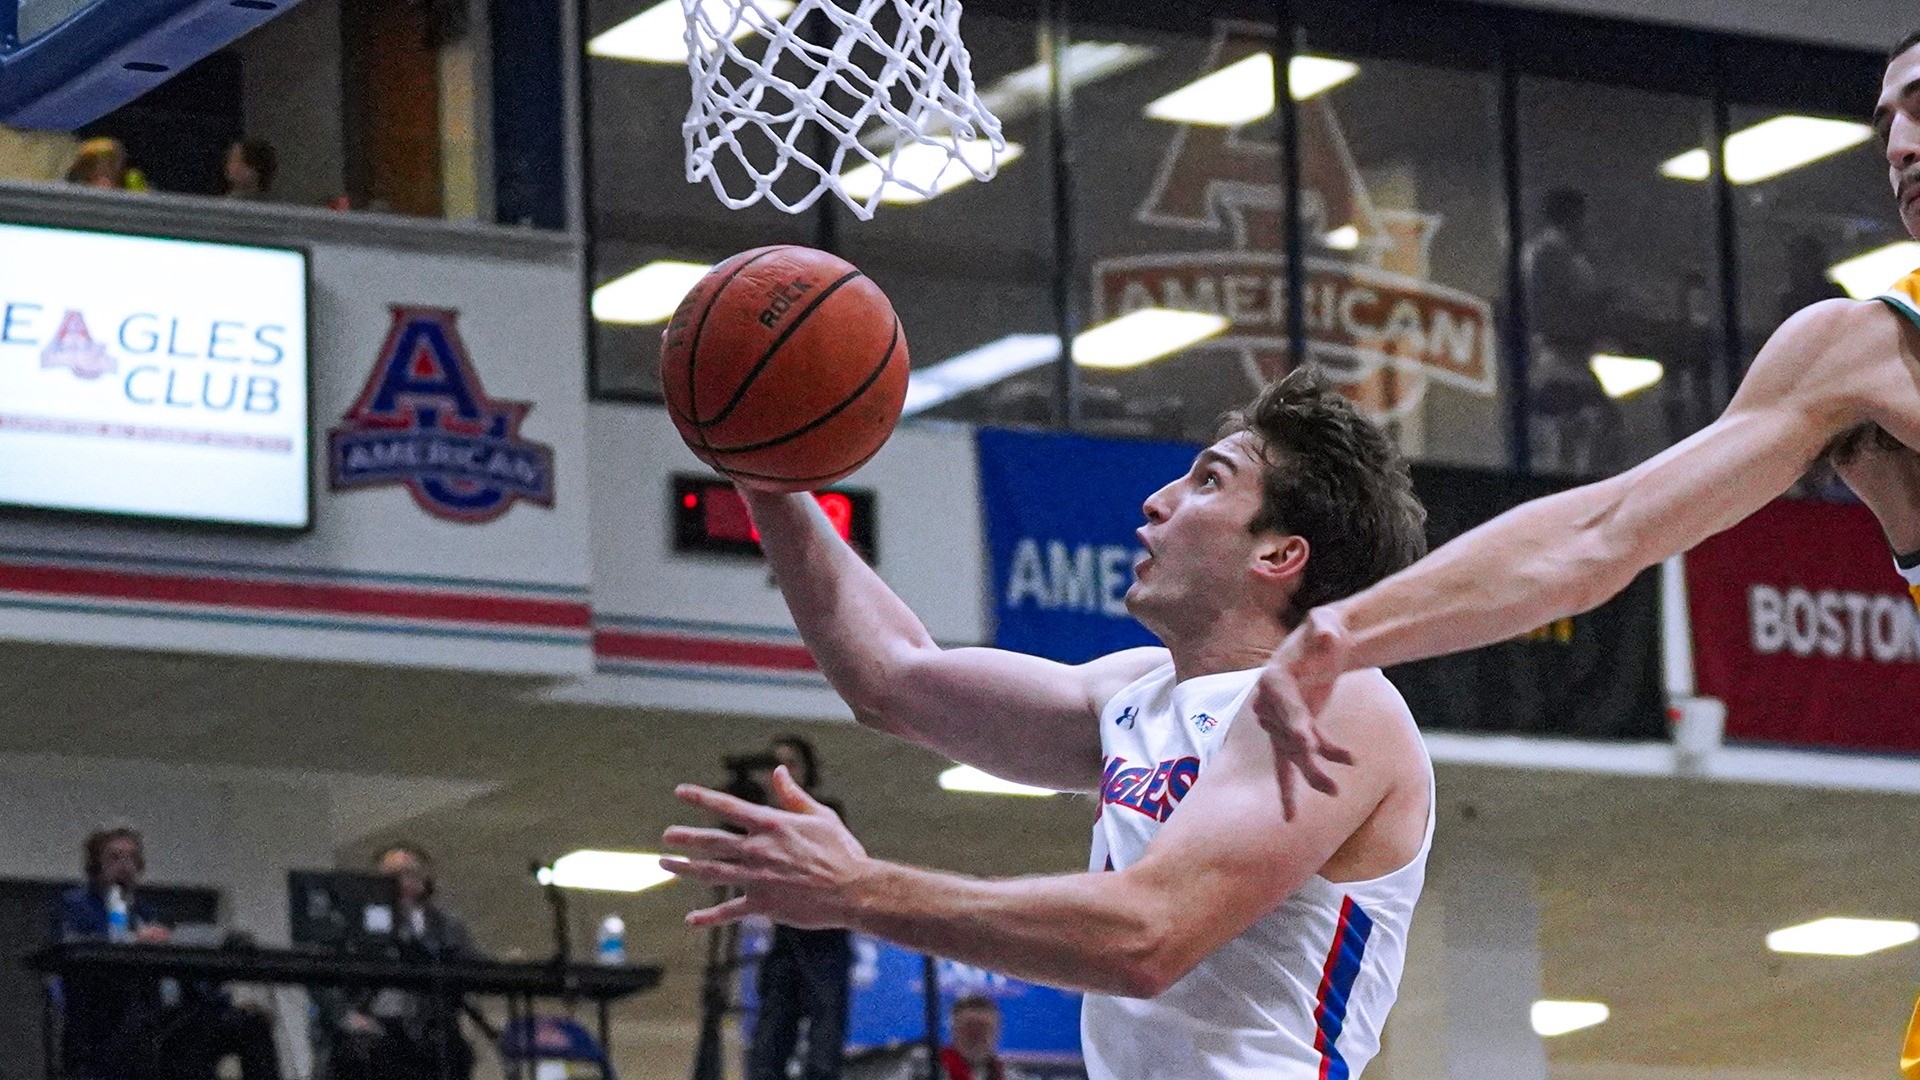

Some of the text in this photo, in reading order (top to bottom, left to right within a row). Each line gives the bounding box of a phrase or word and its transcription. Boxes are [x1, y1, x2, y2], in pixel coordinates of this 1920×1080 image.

[757, 278, 812, 330] ROCK
[123, 364, 281, 415] CLUB
[347, 441, 540, 482] AMERICAN
[1006, 538, 1146, 616] AME
